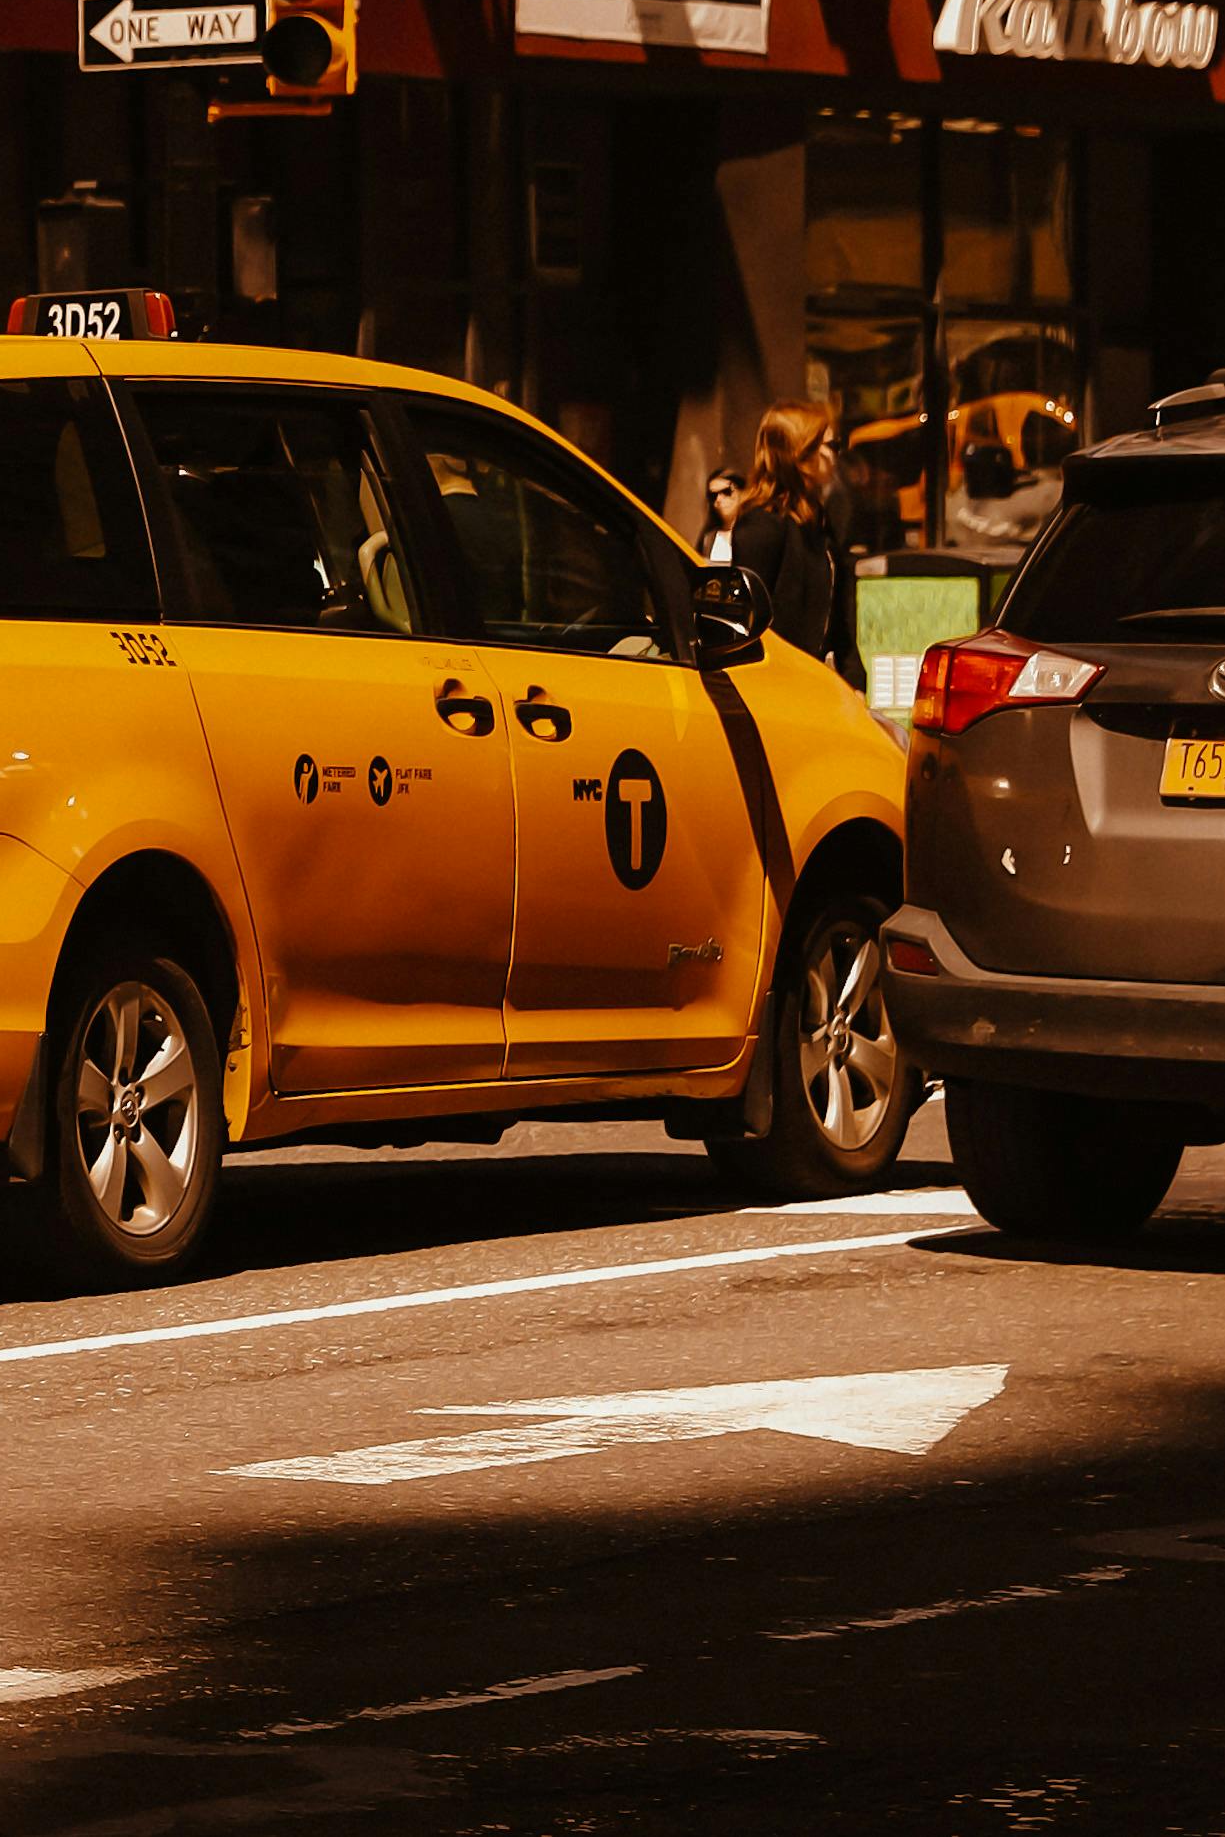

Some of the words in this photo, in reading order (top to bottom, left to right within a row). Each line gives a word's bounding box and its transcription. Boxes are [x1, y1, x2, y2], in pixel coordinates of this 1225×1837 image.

[109, 16, 161, 44] ONE
[187, 13, 243, 40] WAY
[48, 301, 120, 340] 3D52
[1181, 743, 1225, 779] T65
[573, 778, 603, 802] NYC
[618, 778, 652, 871] T
